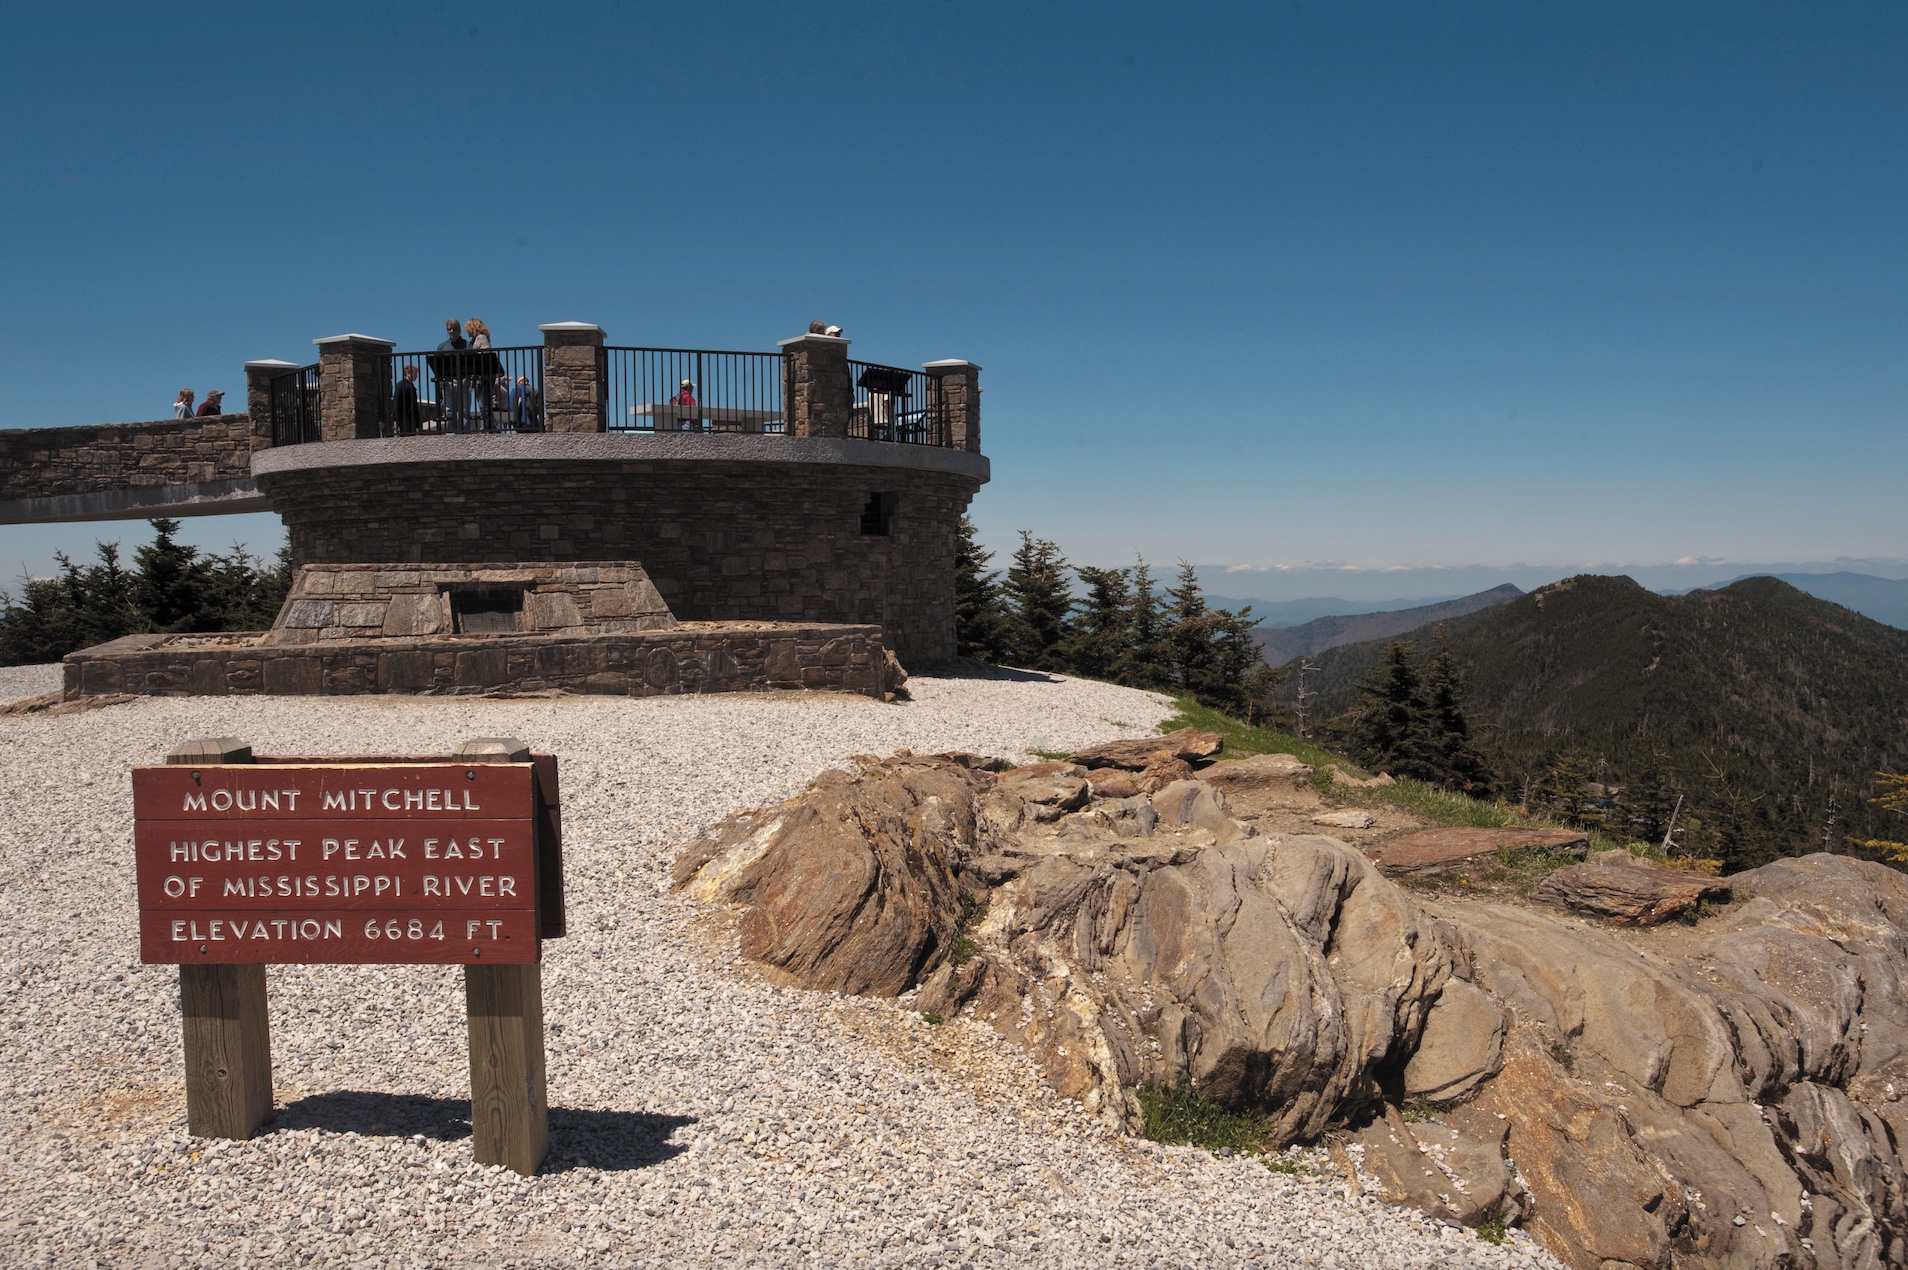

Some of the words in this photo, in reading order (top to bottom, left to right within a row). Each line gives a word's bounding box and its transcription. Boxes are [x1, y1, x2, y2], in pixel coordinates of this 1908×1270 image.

[183, 788, 300, 811] MOUNT
[322, 788, 481, 811] MITCHELL
[170, 839, 301, 862] HIGHEST
[322, 837, 408, 861] PEAK
[424, 837, 506, 860] EAST
[162, 875, 204, 898] OF
[223, 876, 401, 897] MISSISSIPPI
[423, 875, 518, 897] RIVER
[171, 918, 343, 941] ELEVATION
[363, 918, 446, 940] 6684
[466, 919, 503, 940] FT
